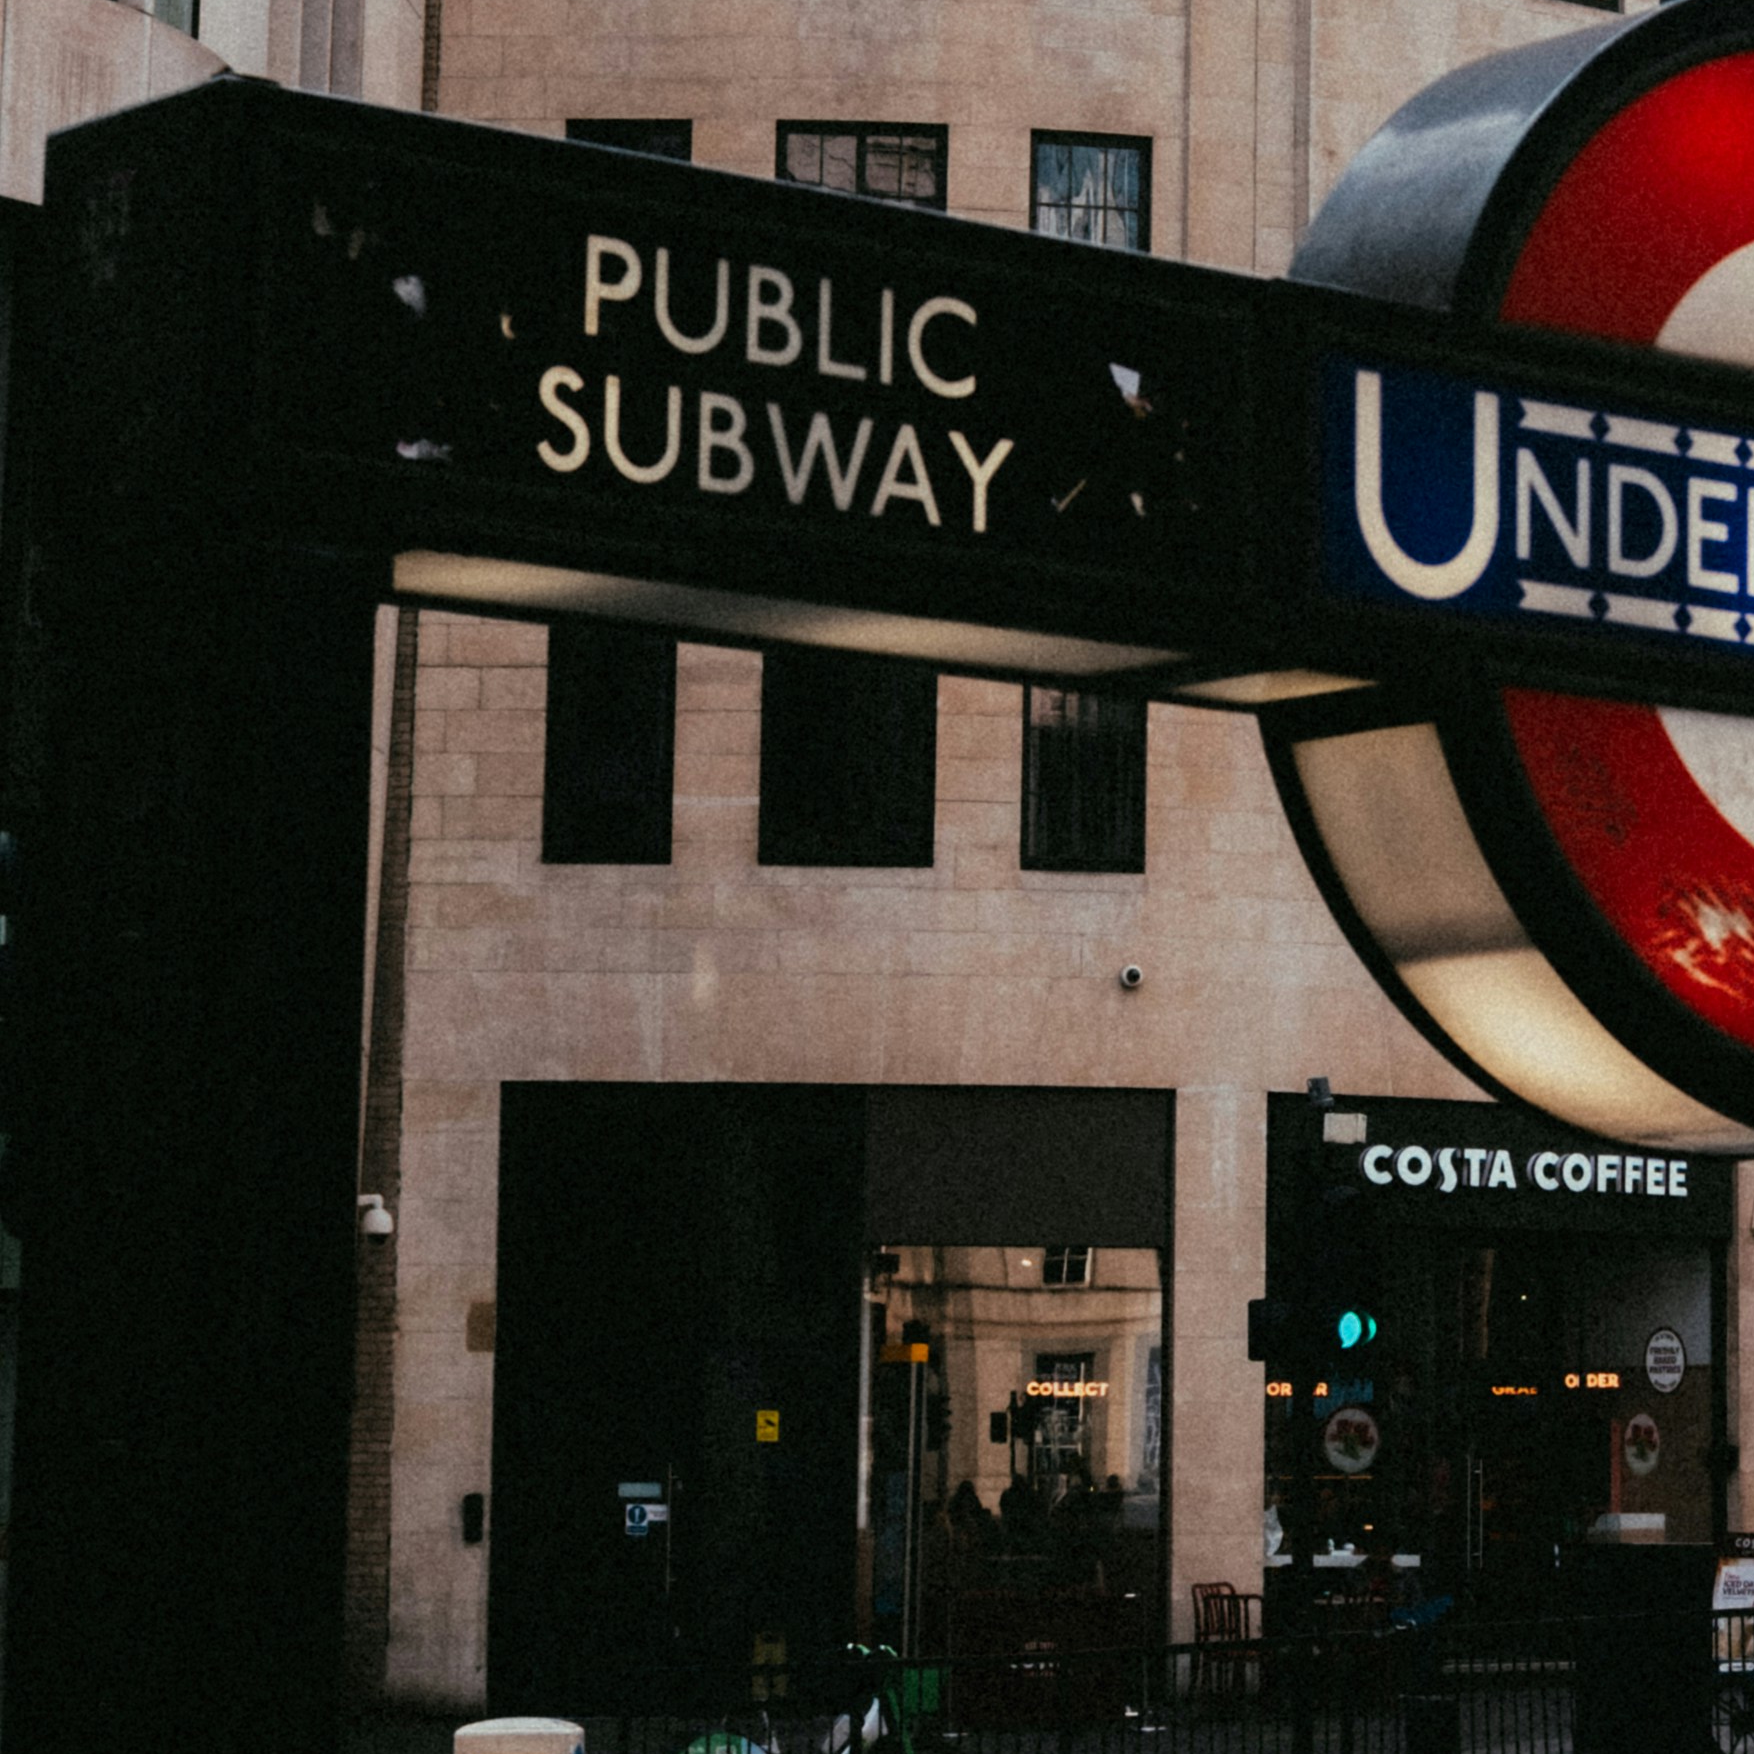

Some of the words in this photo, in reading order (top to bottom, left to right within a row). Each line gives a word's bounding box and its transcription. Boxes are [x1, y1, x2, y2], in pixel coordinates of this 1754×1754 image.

[584, 234, 978, 400] PUBLIC
[536, 365, 1013, 534] SUBWAY
[1361, 1144, 1517, 1193] COSTA
[1528, 1151, 1689, 1197] COFFEE
[1026, 1381, 1108, 1397] COLLECT
